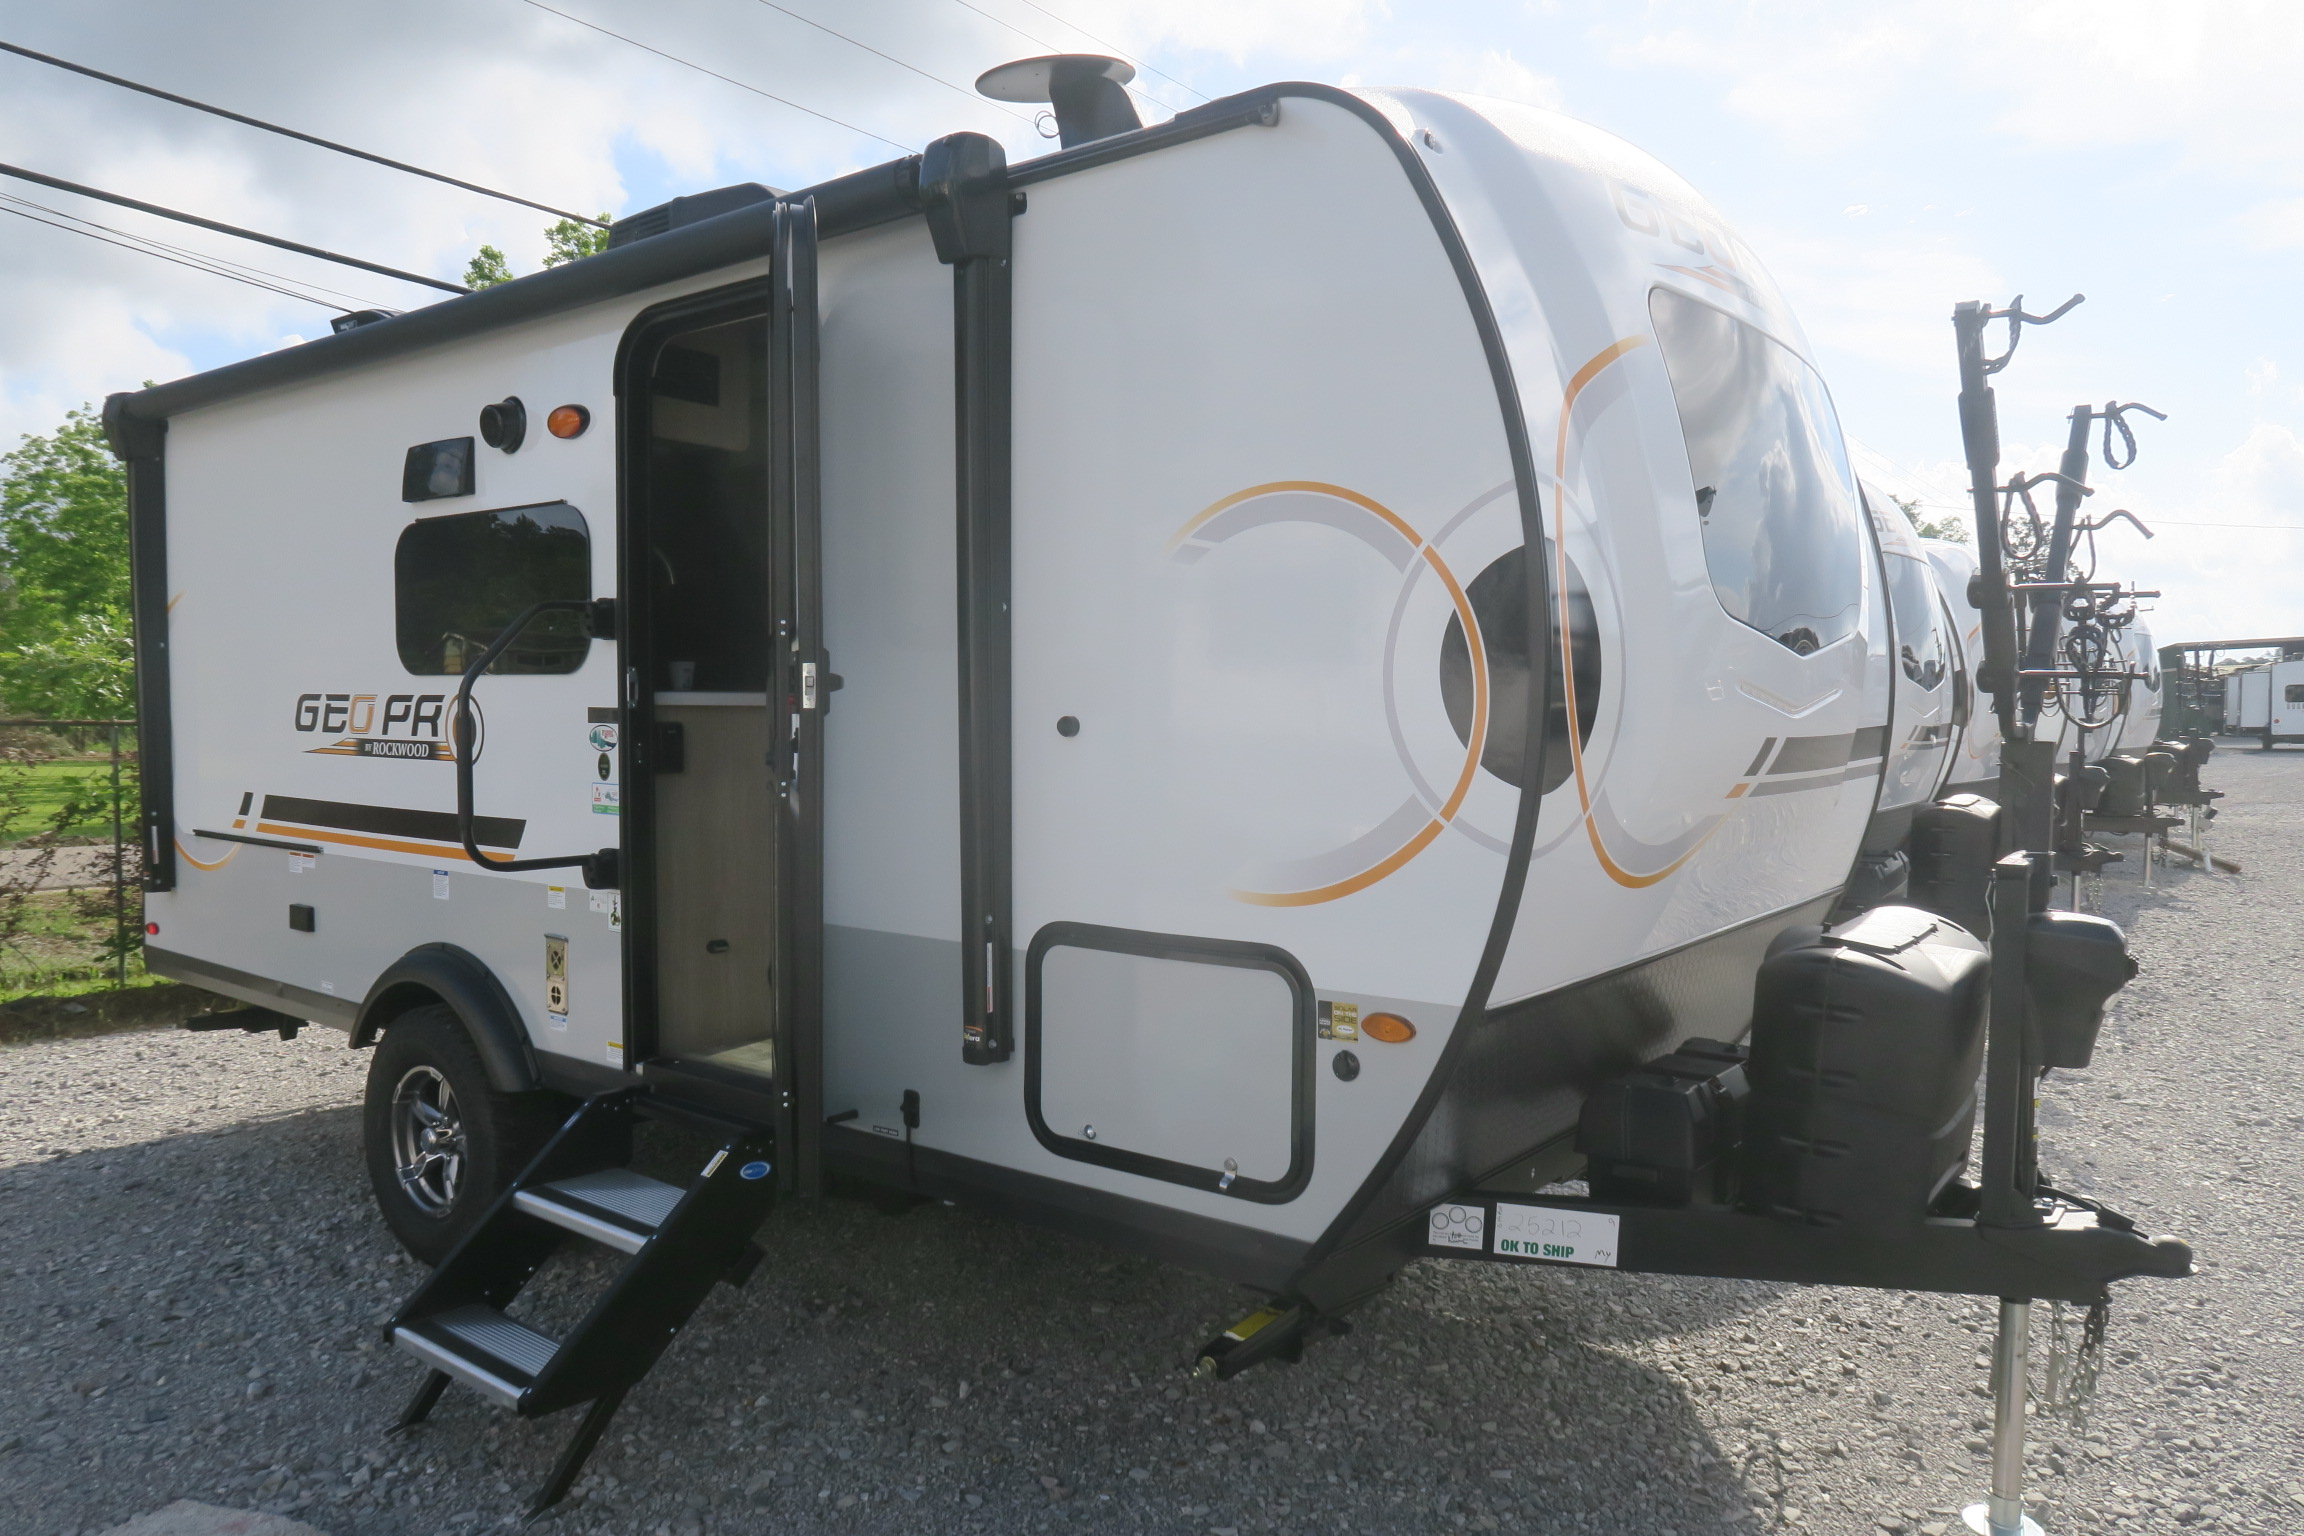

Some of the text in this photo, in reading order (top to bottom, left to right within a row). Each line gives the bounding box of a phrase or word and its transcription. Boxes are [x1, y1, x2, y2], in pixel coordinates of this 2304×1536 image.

[295, 693, 377, 734] GEO
[364, 741, 429, 757] BY ROCKWOOD
[1508, 1213, 1582, 1239] 25212
[1501, 1239, 1575, 1259] OK TO SHIP
